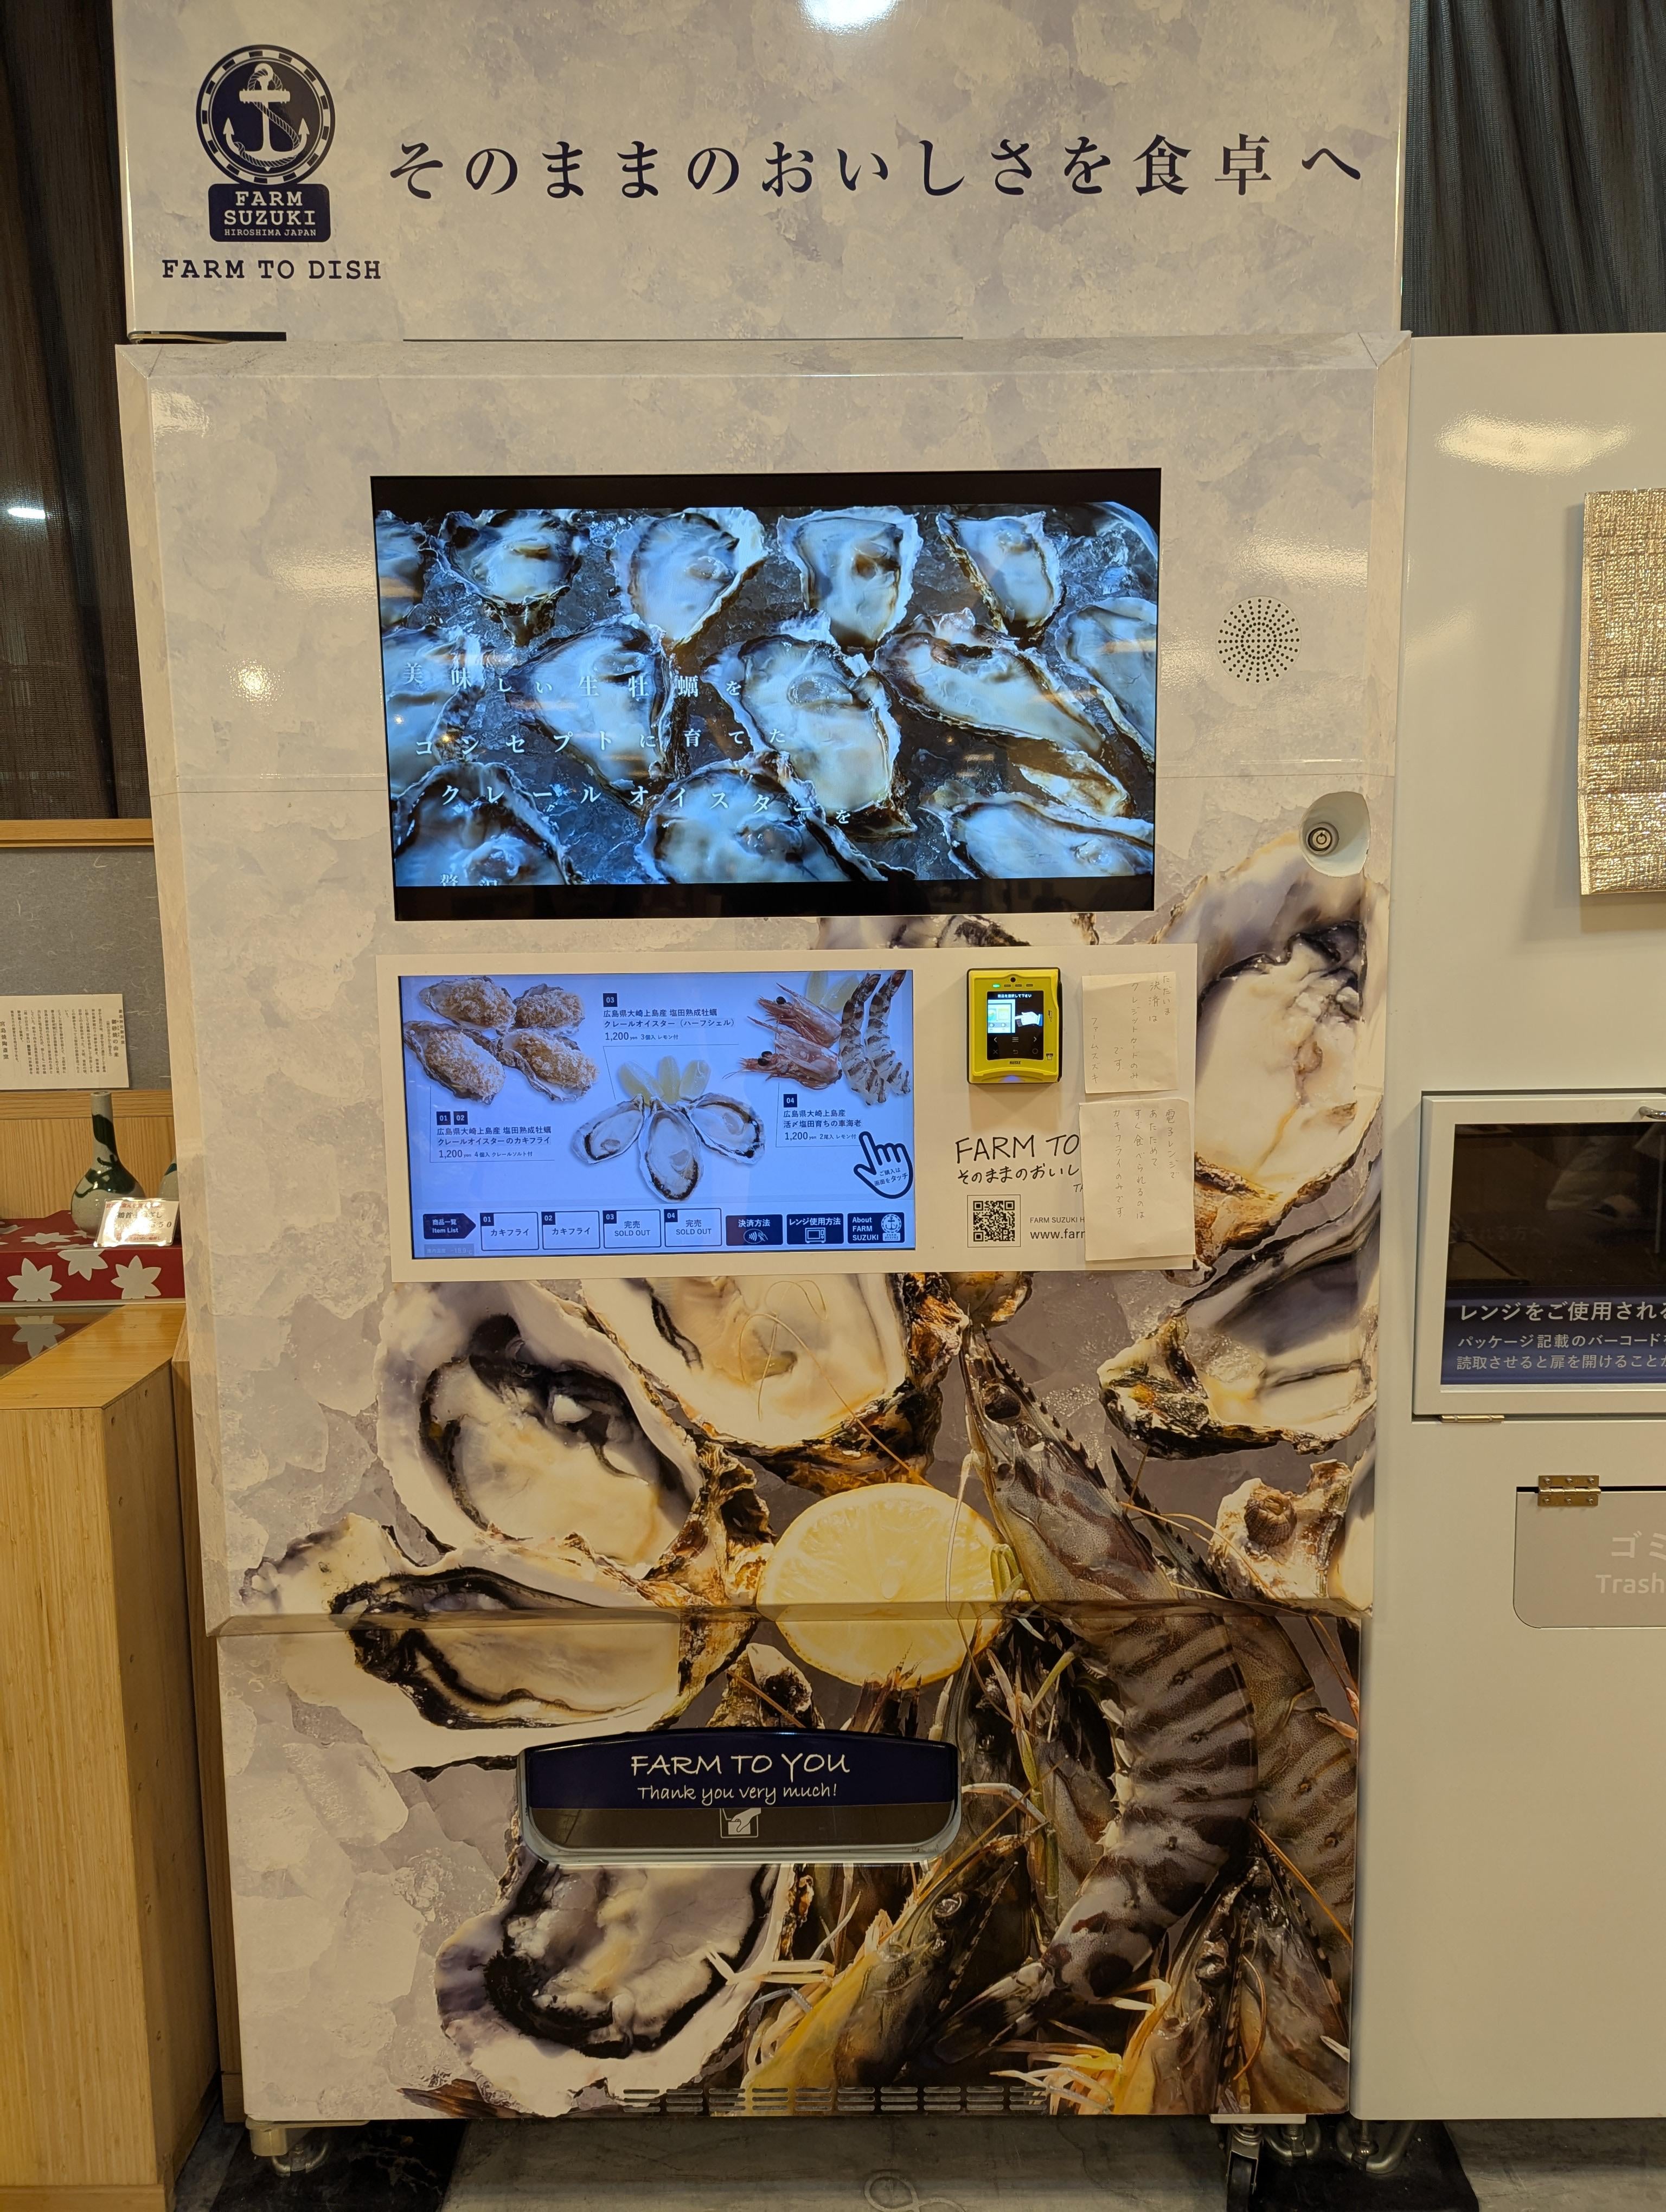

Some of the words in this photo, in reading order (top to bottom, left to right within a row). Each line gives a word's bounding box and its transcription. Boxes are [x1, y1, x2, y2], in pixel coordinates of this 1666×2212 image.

[389, 134, 1361, 199] そのままのおいしさを食卓へ
[235, 191, 303, 206] FARM
[224, 210, 316, 226] SUZUKI
[162, 260, 245, 279] FARM
[258, 260, 294, 279] TO
[308, 260, 381, 279] DISH
[403, 663, 742, 697] 美味しい生牡蠣を
[415, 728, 786, 755] コンセプトに育てた
[441, 785, 849, 824] クレールオイスターを
[1148, 980, 1161, 1023] 決済は
[1163, 975, 1172, 1015] ただいま
[603, 1009, 667, 1018] 広島県大崎上島産
[605, 1032, 629, 1041] 1,200
[1130, 982, 1140, 1079] クレジットカードのみ
[1091, 1018, 1100, 1084] ファームスズキ
[783, 1109, 846, 1118] 広島県大崎上島産
[437, 1127, 501, 1136] 広島県大崎上島産
[785, 1131, 808, 1141] 1,200
[438, 1136, 550, 1146] クレールオイスターのカキフライ
[955, 1134, 1035, 1164] FARM
[1046, 1134, 1079, 1156] TO
[1165, 1109, 1180, 1179] 電子レンジで
[439, 1149, 463, 1159] 1,200
[879, 1167, 901, 1177] ご購入は
[1133, 1109, 1146, 1219] すぐ食べられるのは
[874, 1172, 909, 1186] 画面をタッチ
[624, 1220, 640, 1229] 完売
[685, 1219, 702, 1227] 完売
[738, 1219, 771, 1227] 決済方法
[789, 1217, 841, 1226] レンジ使用方法
[490, 1228, 529, 1237] カキフライ
[552, 1227, 591, 1236] カキフライ
[1458, 1333, 1666, 1349] パッケージ記載のバーコード
[1595, 1572, 1664, 1593] Trash
[631, 1754, 722, 1776] FARM
[731, 1755, 772, 1774] TO
[781, 1753, 850, 1783] YOU
[637, 1785, 696, 1800] Thank
[702, 1787, 733, 1806] you
[739, 1785, 776, 1805] very
[783, 1783, 837, 1798] much!
